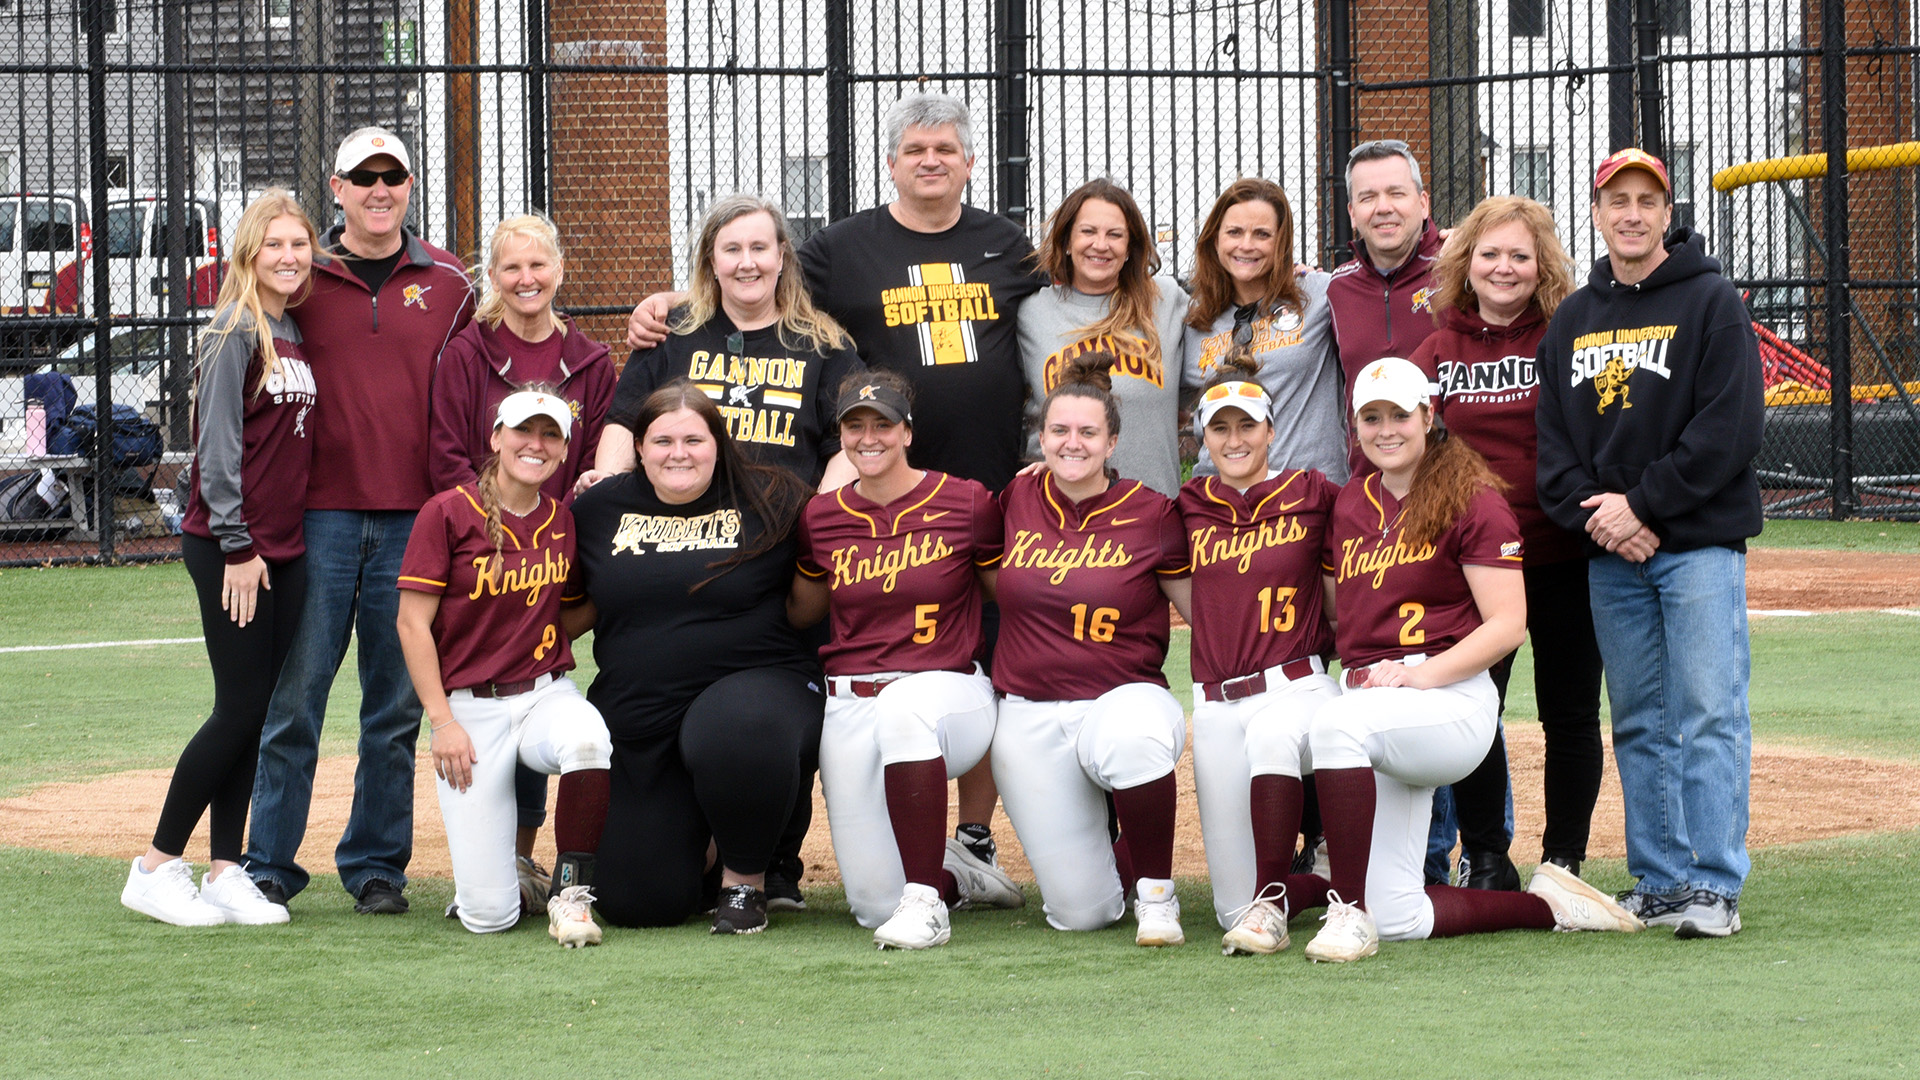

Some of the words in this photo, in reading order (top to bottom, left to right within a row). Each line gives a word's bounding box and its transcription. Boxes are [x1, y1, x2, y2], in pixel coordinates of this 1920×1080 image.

[881, 286, 927, 305] GANNON
[928, 283, 990, 300] UNIVERSITY
[883, 297, 1000, 327] SOFTBALL
[1573, 330, 1614, 352] GANNON
[1616, 325, 1678, 343] UNIVERSITY
[688, 350, 807, 388] GANNON
[1437, 355, 1540, 402] GANNO
[1571, 338, 1671, 388] SOFTBALL
[1459, 390, 1531, 403] UNIVERSITY
[716, 405, 796, 447] TBALL
[612, 509, 741, 544] KNIGHTS
[656, 537, 738, 552] SOFTBALL
[1191, 514, 1308, 574] Knights
[831, 532, 954, 593] Knights
[1002, 529, 1133, 586] Knights
[912, 603, 940, 645] 5
[1070, 603, 1121, 643] 16
[1257, 586, 1298, 634] 13
[1399, 602, 1425, 646] 2
